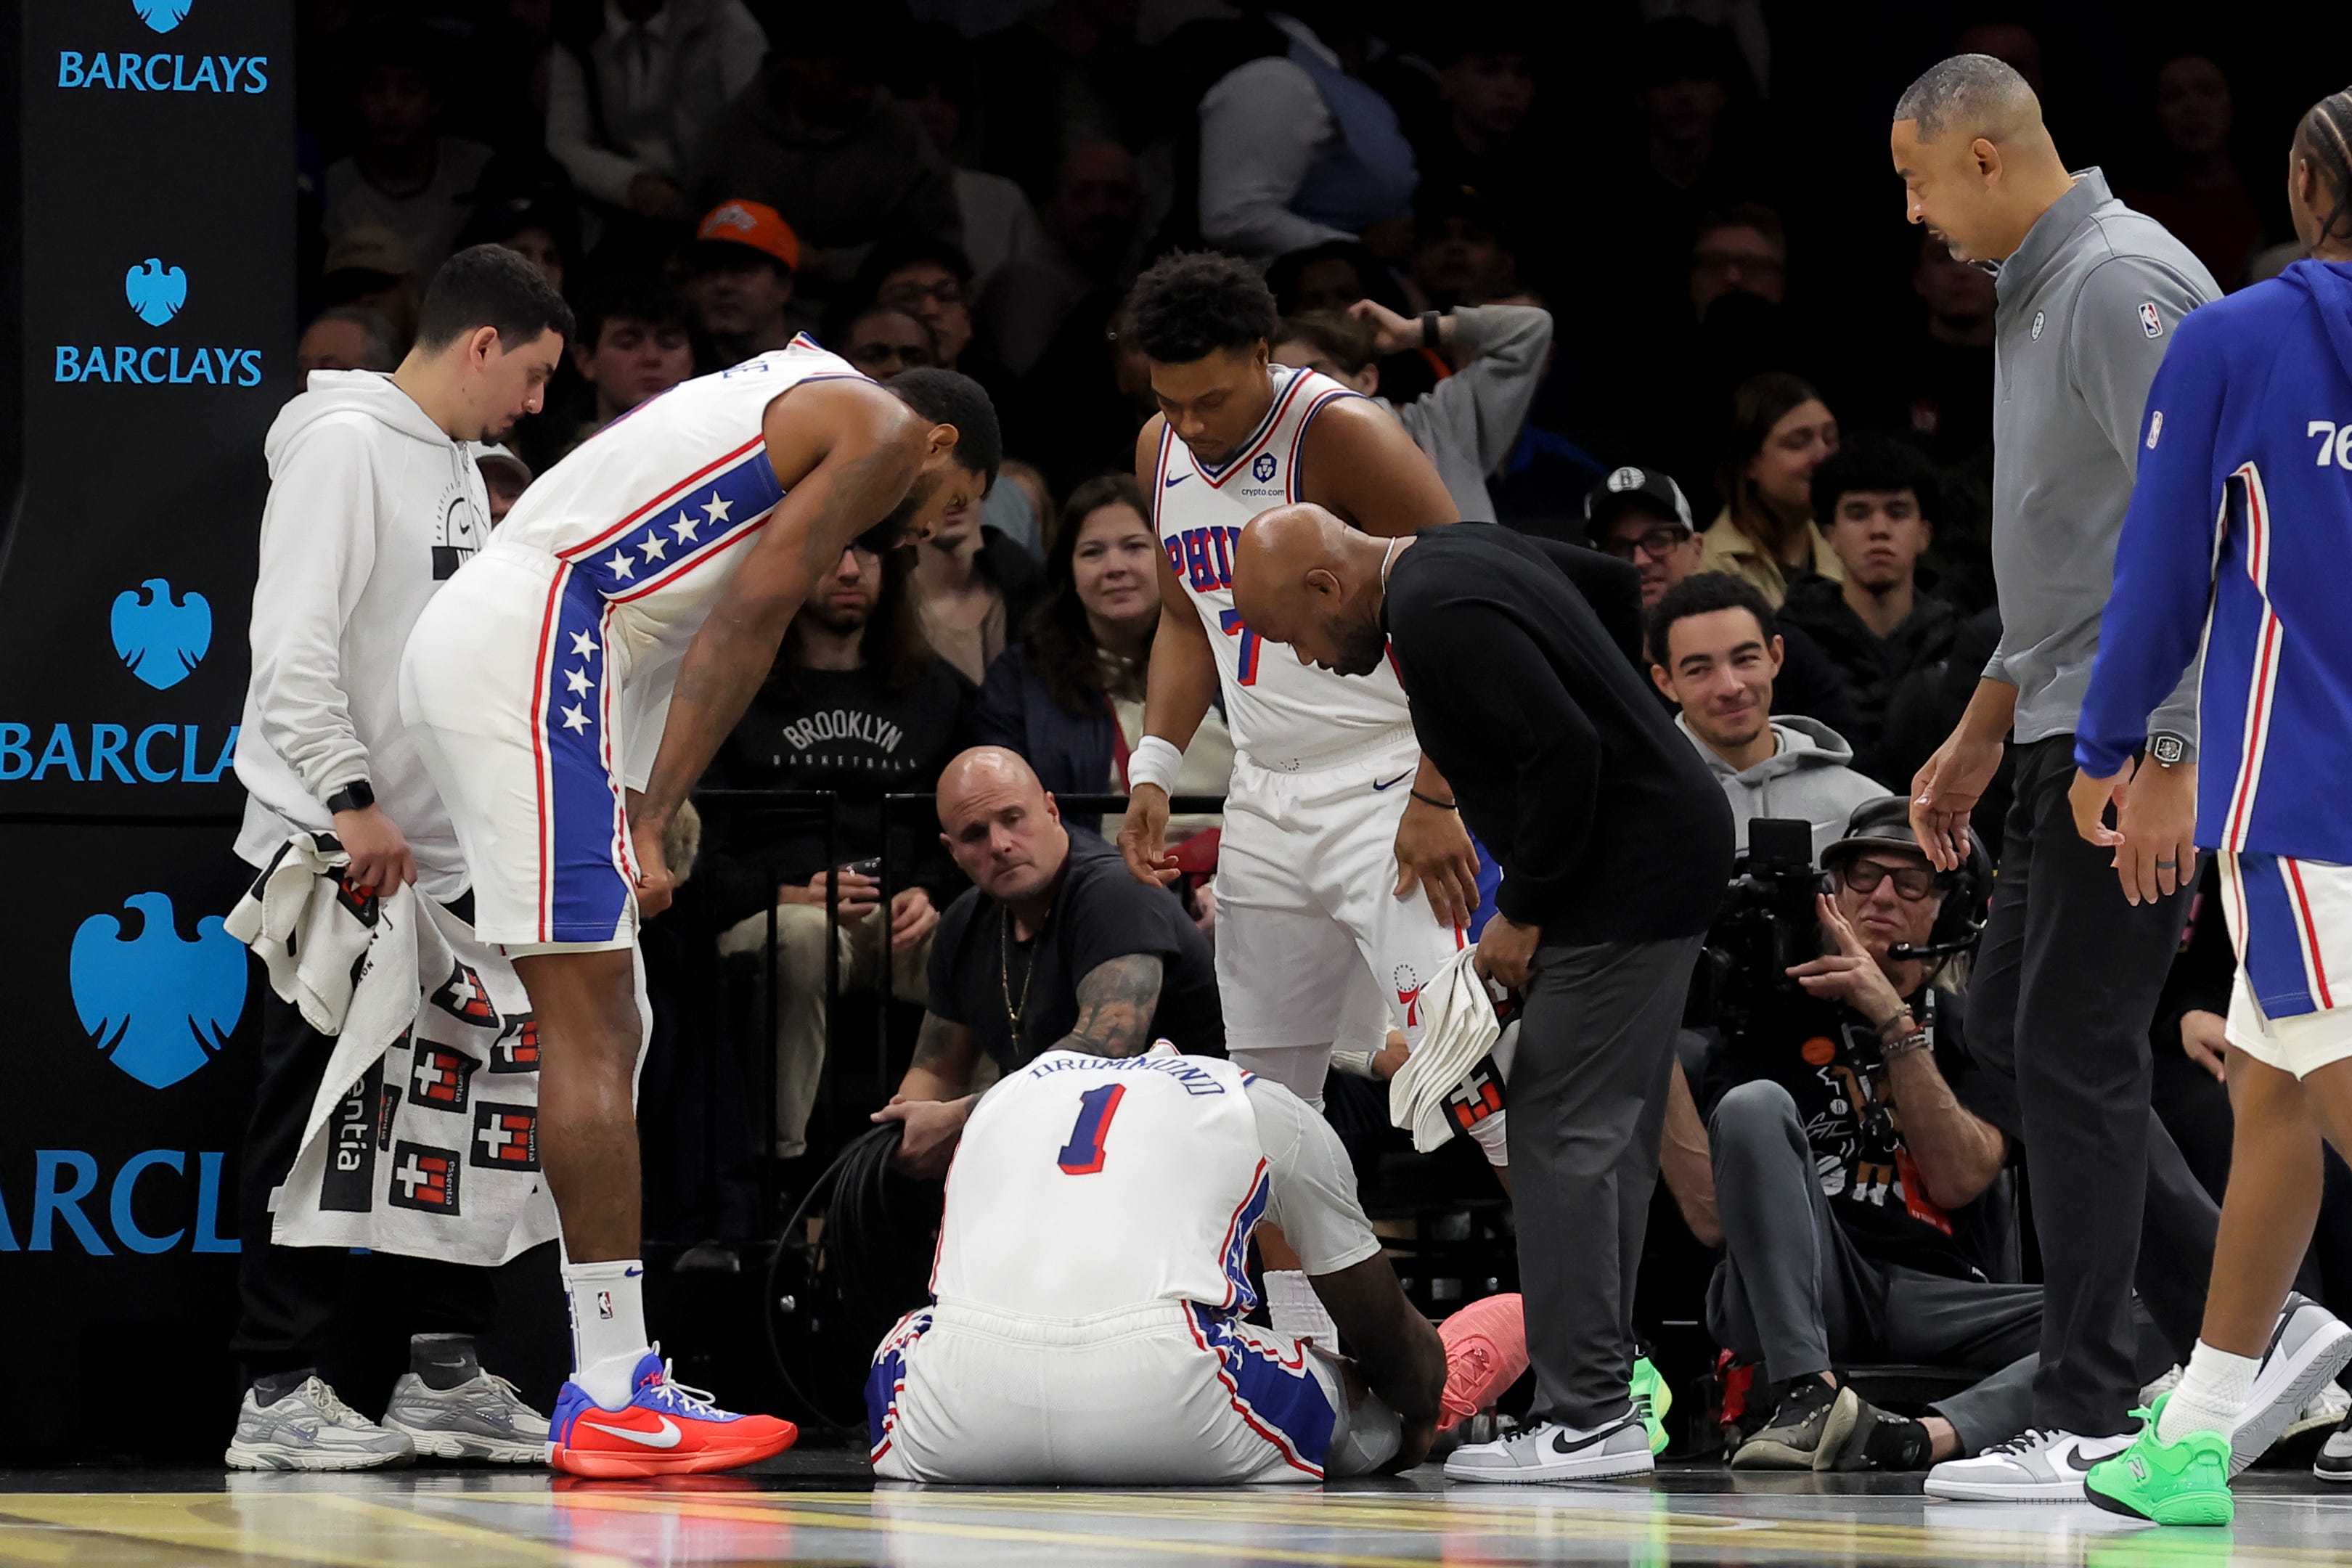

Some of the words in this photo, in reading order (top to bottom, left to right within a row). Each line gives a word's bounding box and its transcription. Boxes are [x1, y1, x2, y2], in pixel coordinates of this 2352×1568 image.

[58, 51, 268, 94] BARCLAYS
[54, 346, 262, 387] BARCLAYS
[1241, 487, 1285, 497] crypto.com
[1219, 608, 1262, 687] 7
[783, 709, 903, 754] BROOKLYN
[1029, 1056, 1225, 1095] DRUMMOND
[1057, 1082, 1127, 1175] 1
